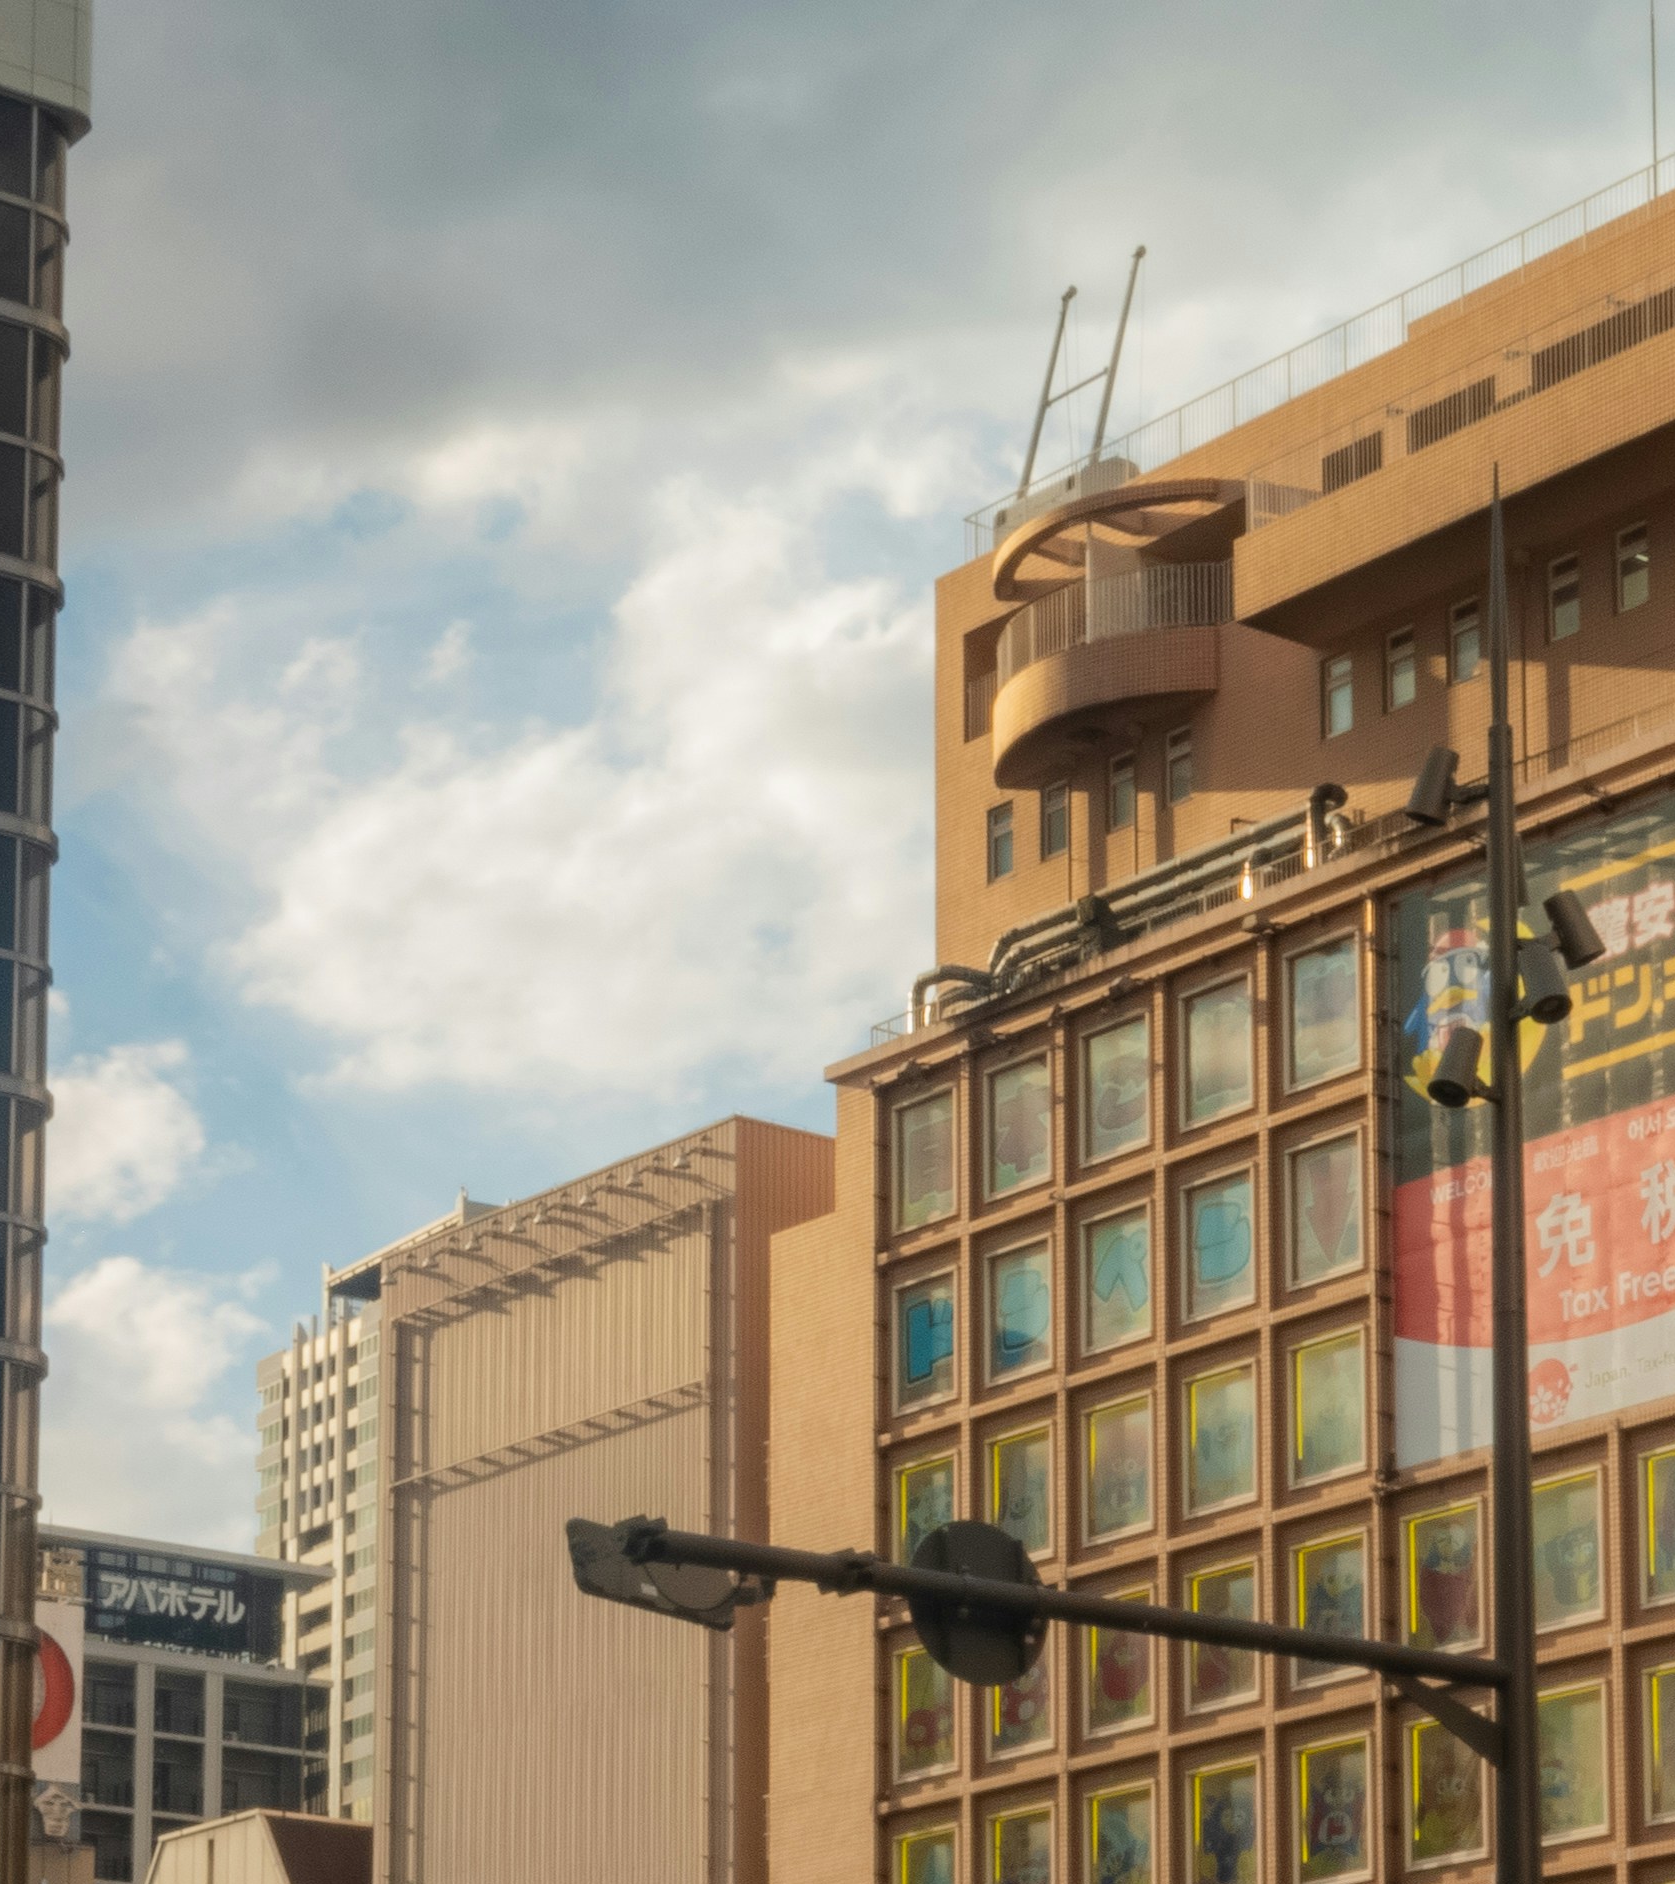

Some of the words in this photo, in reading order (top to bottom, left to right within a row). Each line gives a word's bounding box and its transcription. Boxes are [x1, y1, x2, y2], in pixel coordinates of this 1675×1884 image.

[1560, 1287, 1609, 1322] Tax
[100, 1573, 245, 1625] アパホテル
